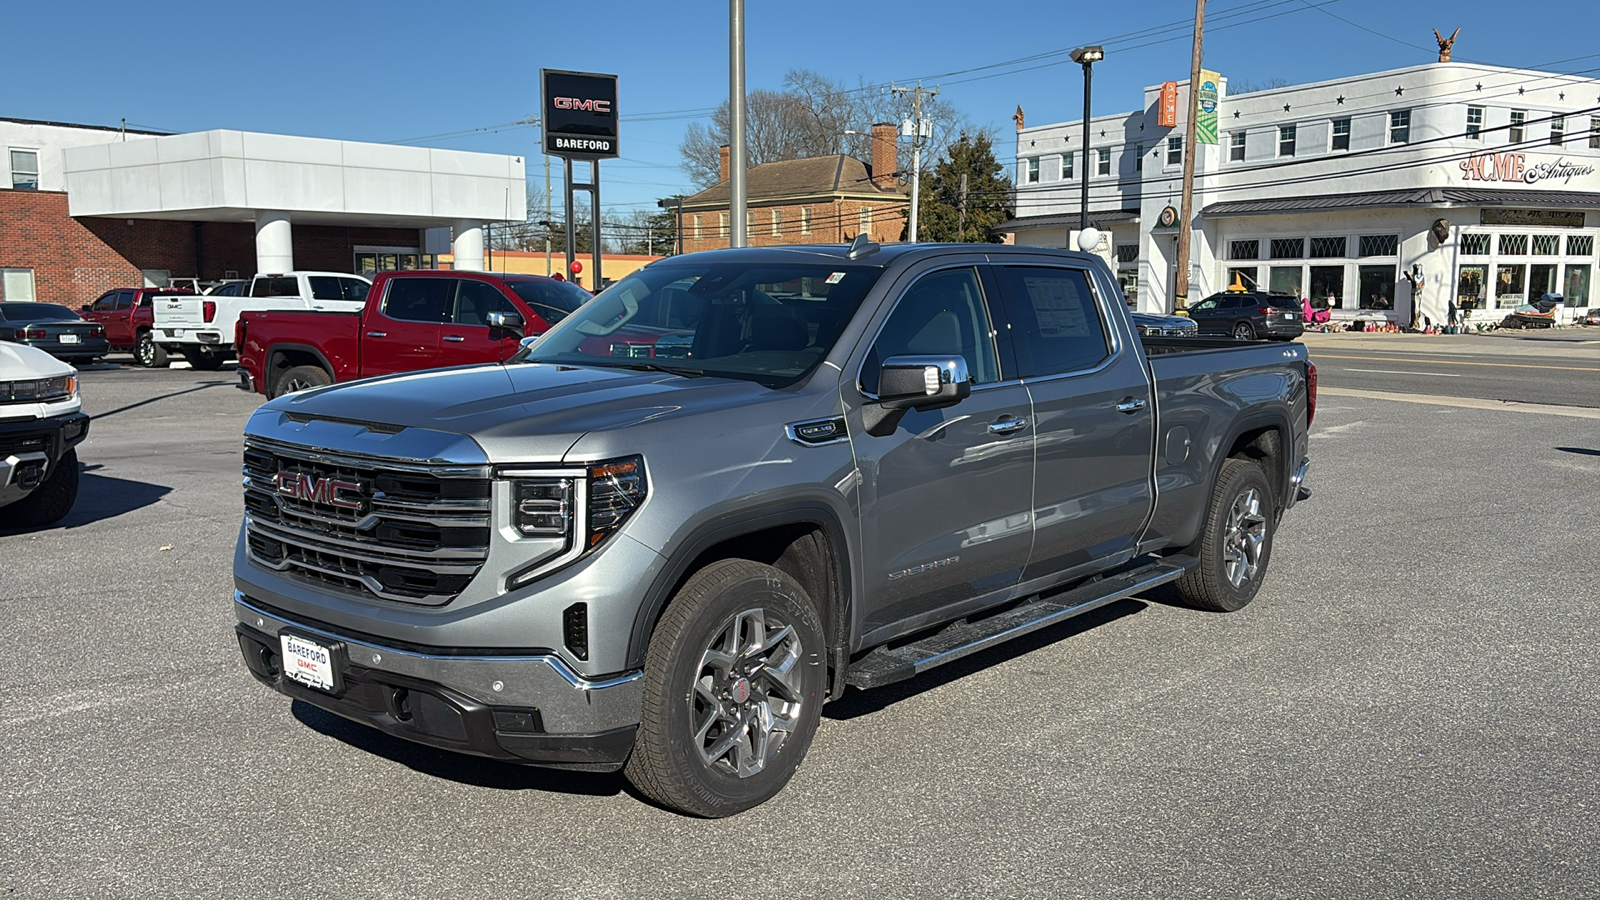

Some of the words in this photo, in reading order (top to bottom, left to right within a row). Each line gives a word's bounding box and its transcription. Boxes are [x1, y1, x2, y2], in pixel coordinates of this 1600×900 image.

[554, 97, 610, 112] GMC
[556, 138, 609, 150] BAREFORD
[1459, 152, 1525, 182] ACME
[276, 471, 362, 510] GMC
[888, 555, 960, 581] SIERRA
[287, 641, 326, 664] BAREFORD
[297, 658, 318, 673] GMC
